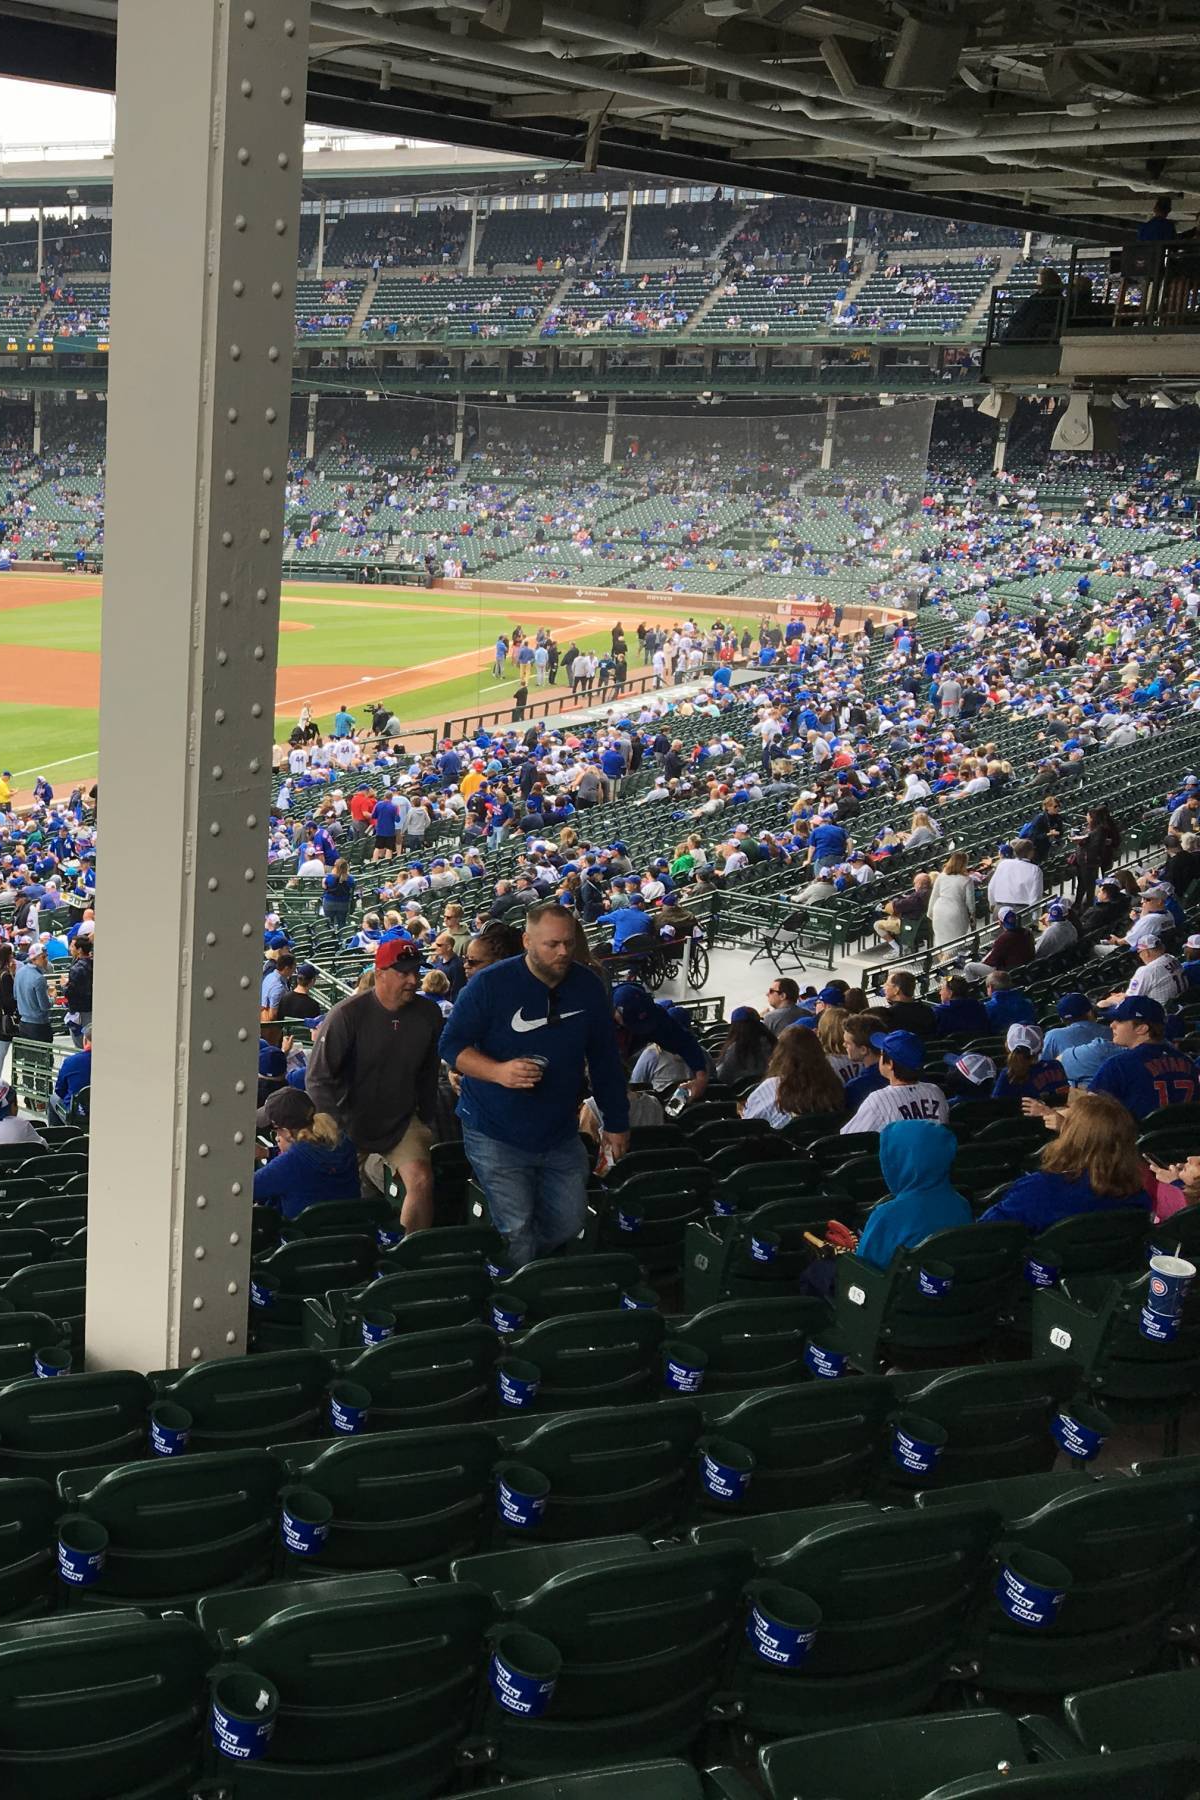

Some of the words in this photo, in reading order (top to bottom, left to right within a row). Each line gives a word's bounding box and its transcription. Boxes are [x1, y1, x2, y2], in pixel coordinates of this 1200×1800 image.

[1154, 1080, 1195, 1107] 17
[1055, 1331, 1067, 1345] 16
[899, 1446, 921, 1460] Hefty
[1064, 1440, 1088, 1456] Hefty
[904, 1459, 928, 1472] Hefty
[709, 1482, 733, 1496] Hefty
[503, 1509, 526, 1524] Hefty
[1006, 1587, 1035, 1610] Hefty
[1011, 1604, 1044, 1622] Hefty
[760, 1645, 790, 1663] Hefty
[501, 1693, 532, 1713] Hefty
[220, 1740, 251, 1758] Hefty
